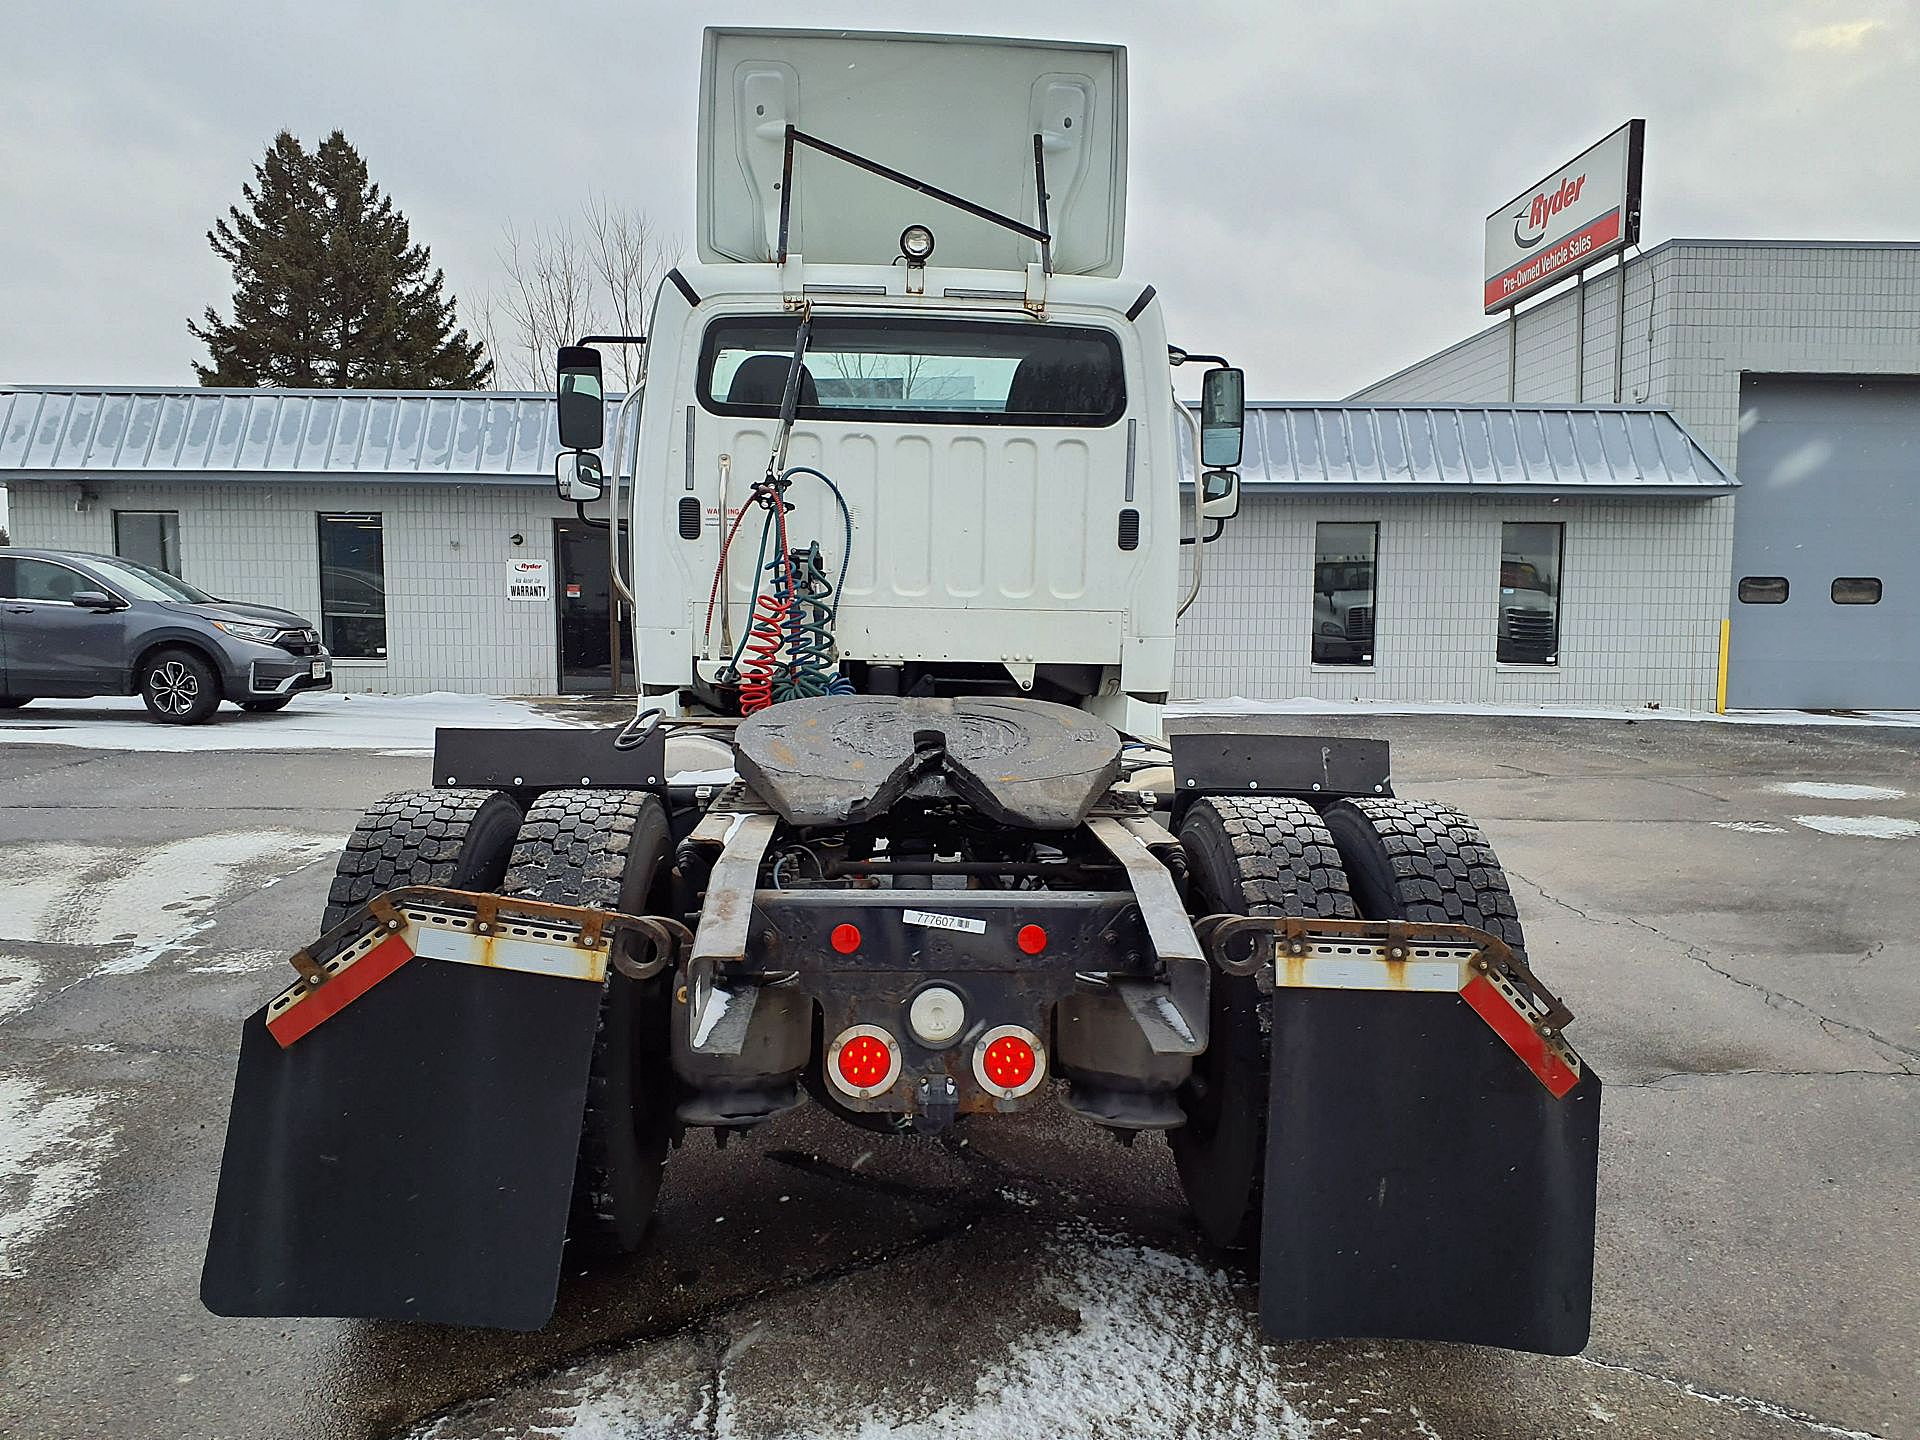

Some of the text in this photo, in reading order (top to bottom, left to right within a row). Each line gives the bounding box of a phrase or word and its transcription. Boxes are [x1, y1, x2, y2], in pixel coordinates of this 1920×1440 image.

[1528, 173, 1586, 230] Ryder
[1503, 234, 1592, 293] Pre-Owned Vehicle Sales
[706, 507, 740, 515] WAING
[510, 585, 547, 597] WARRANTY
[916, 912, 956, 927] 777607
